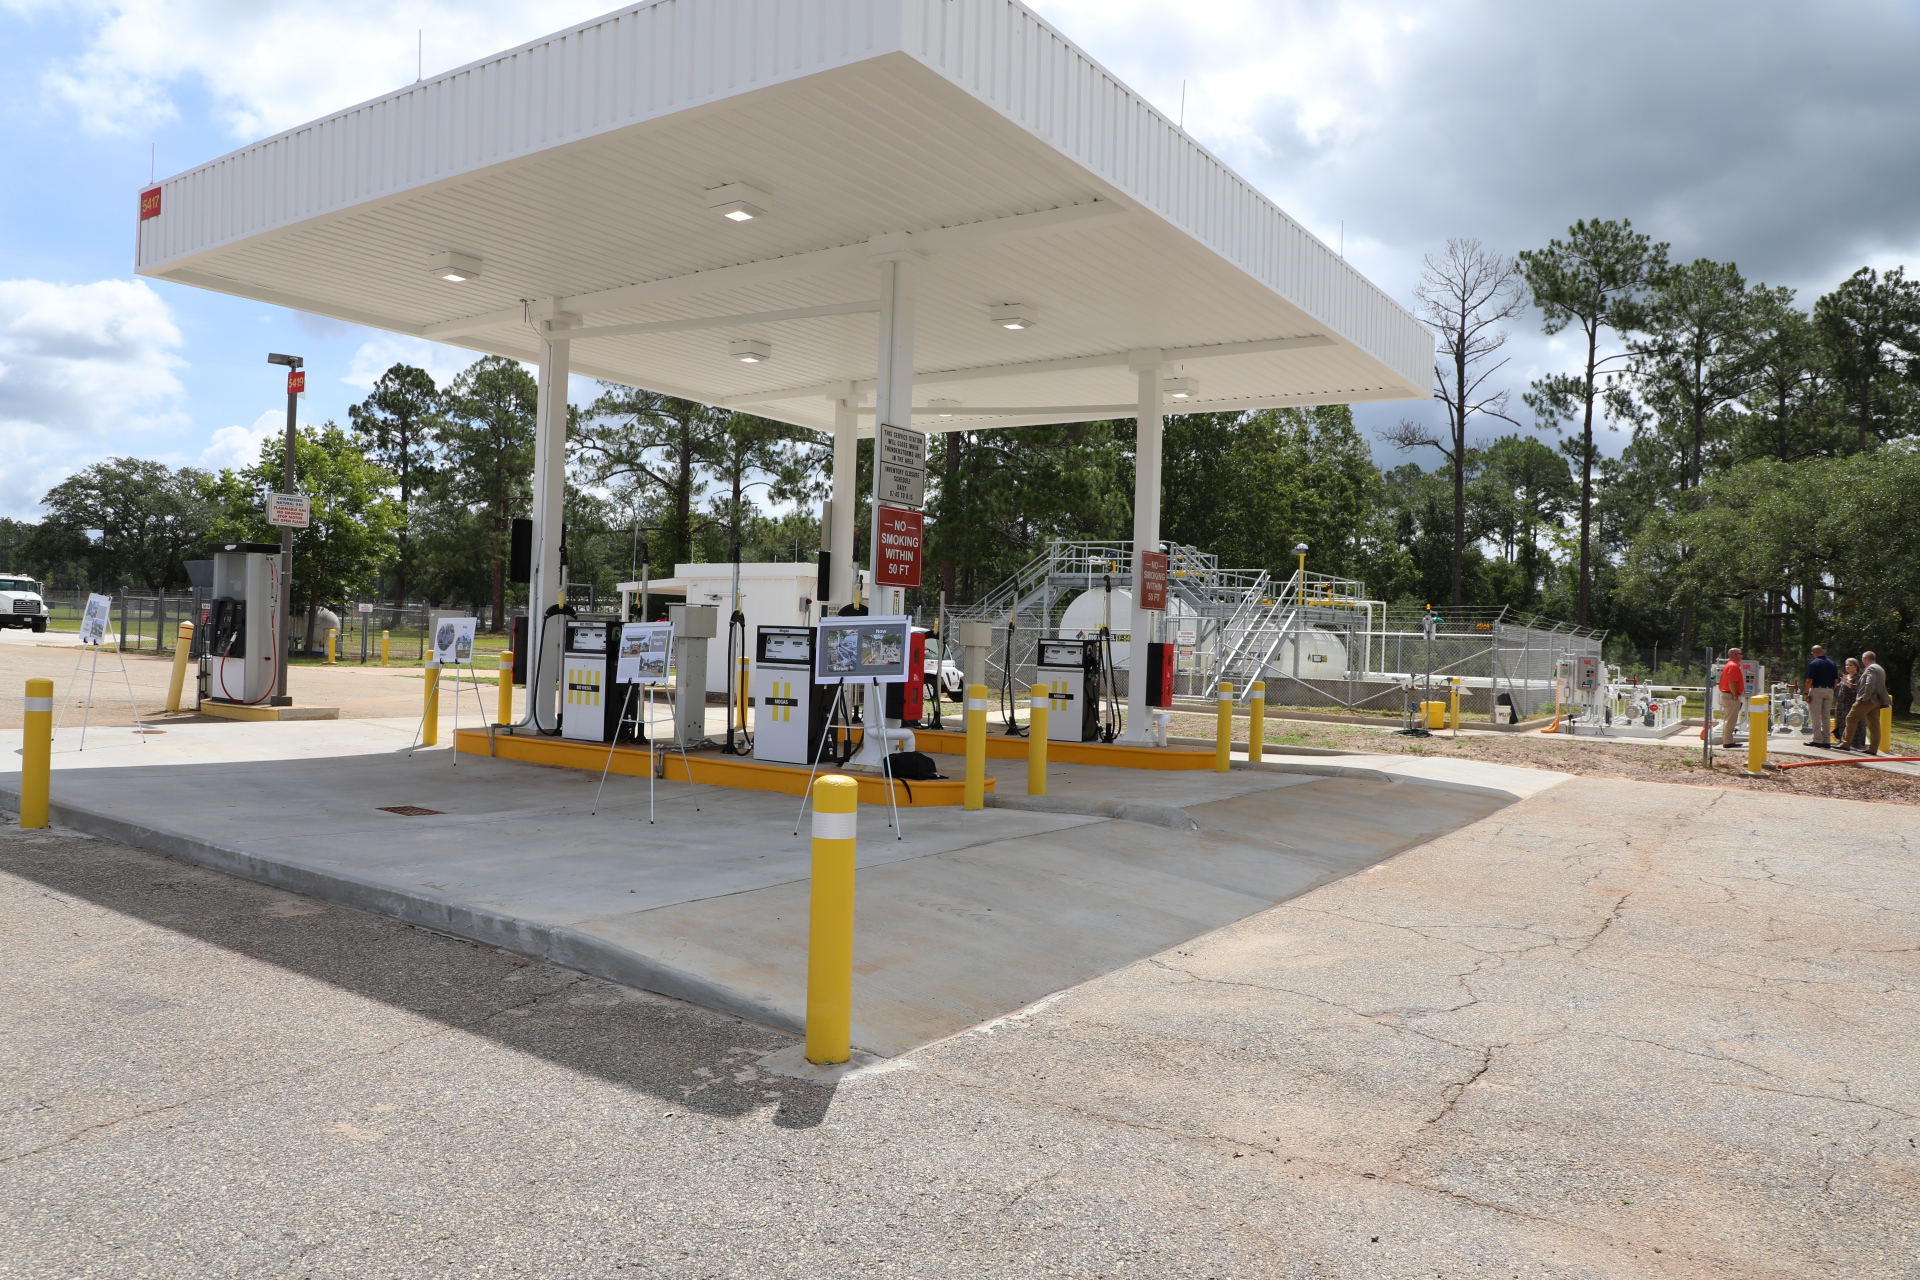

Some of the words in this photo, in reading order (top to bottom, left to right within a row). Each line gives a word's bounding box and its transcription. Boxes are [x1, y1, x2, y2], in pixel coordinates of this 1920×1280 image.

[142, 194, 160, 213] 5417
[893, 431, 908, 441] SERVICE
[909, 435, 923, 444] STATION
[888, 438, 897, 446] WILL
[897, 440, 908, 449] CLOSE
[909, 443, 919, 451] WHEN
[884, 445, 914, 458] THUNDERSTORMS
[885, 466, 904, 475] INVENTORY
[905, 470, 920, 479] CLOSURE
[893, 475, 911, 484] SCHEDULE
[894, 519, 907, 532] NO
[881, 532, 919, 548] SMOKING
[885, 548, 914, 561] WITHIN
[888, 563, 898, 574] 50
[899, 564, 910, 576] FT
[1151, 561, 1159, 570] NO
[1143, 570, 1166, 581] SMOKING
[1145, 581, 1163, 591] WITHIN
[1147, 592, 1154, 601] 50
[1153, 593, 1161, 602] FT
[767, 636, 772, 645] 6
